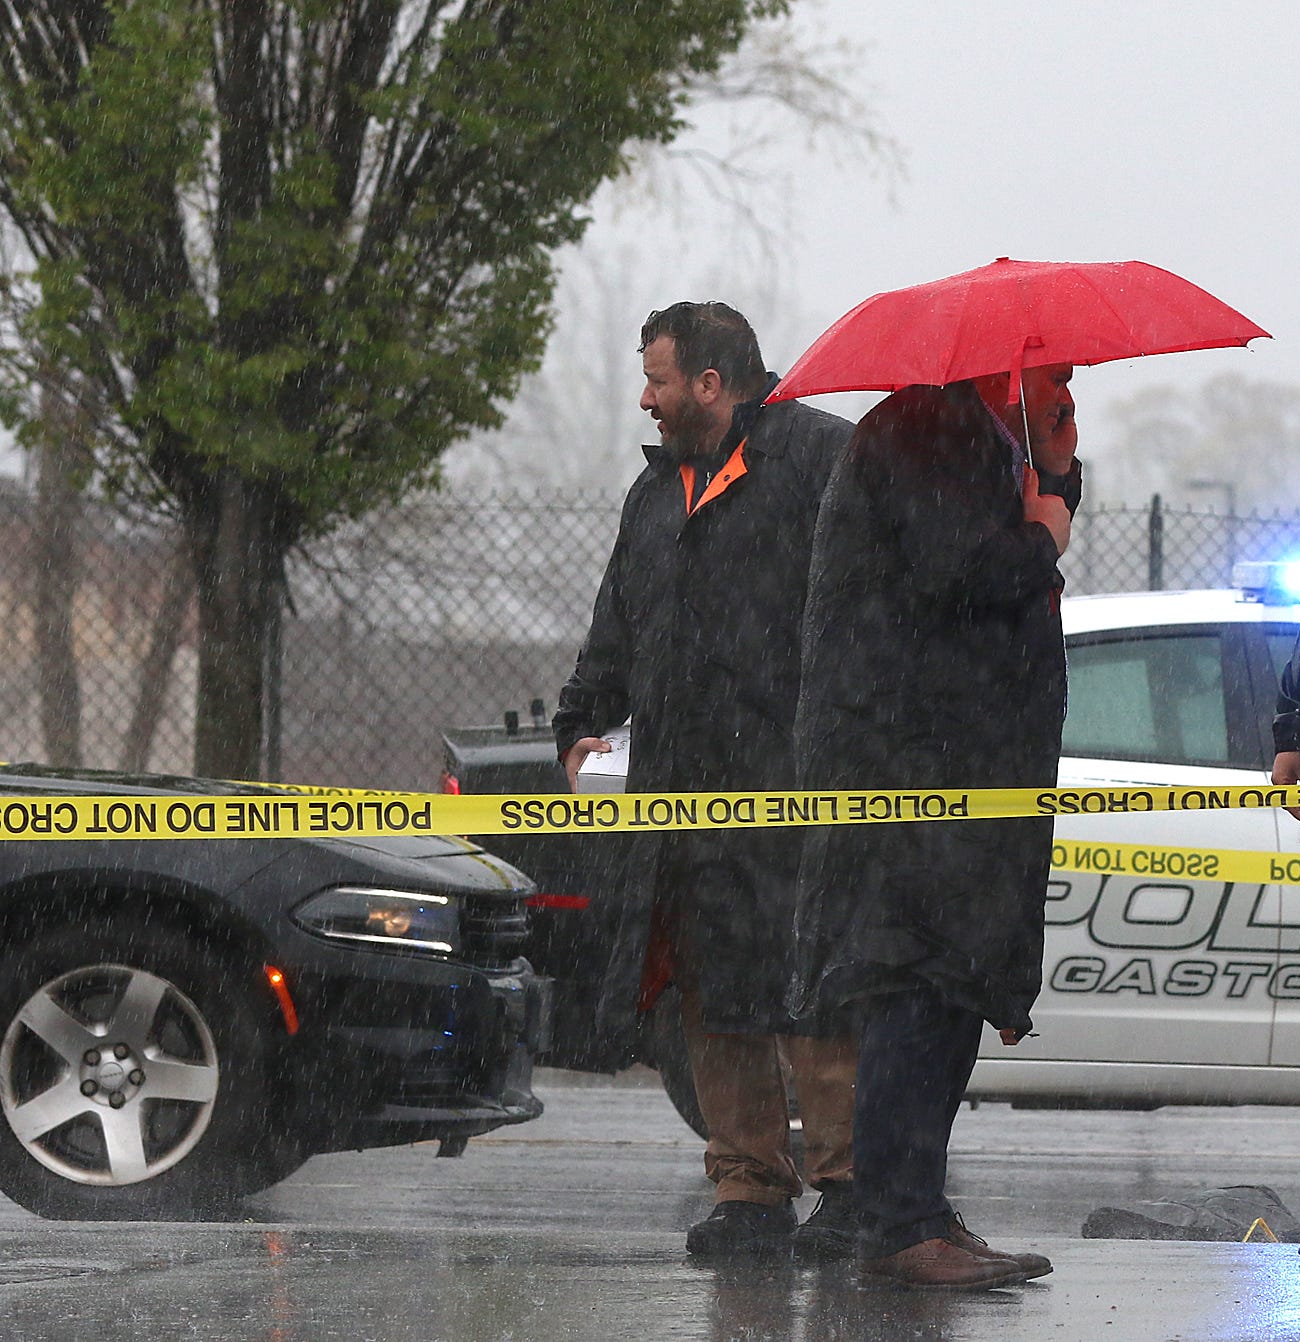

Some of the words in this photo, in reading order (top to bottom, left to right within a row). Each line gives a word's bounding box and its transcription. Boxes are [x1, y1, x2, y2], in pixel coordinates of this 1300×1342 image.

[167, 802, 216, 833] DO
[226, 802, 300, 833] LINE
[308, 801, 432, 832] POLICE
[500, 799, 620, 829] CROSS
[628, 799, 697, 826] NOT
[706, 798, 756, 824] DO
[765, 797, 838, 822] LINE
[848, 794, 969, 820] POLICE
[1037, 791, 1153, 814] CROSS
[0, 803, 78, 834] CRO
[86, 802, 157, 834] NOT
